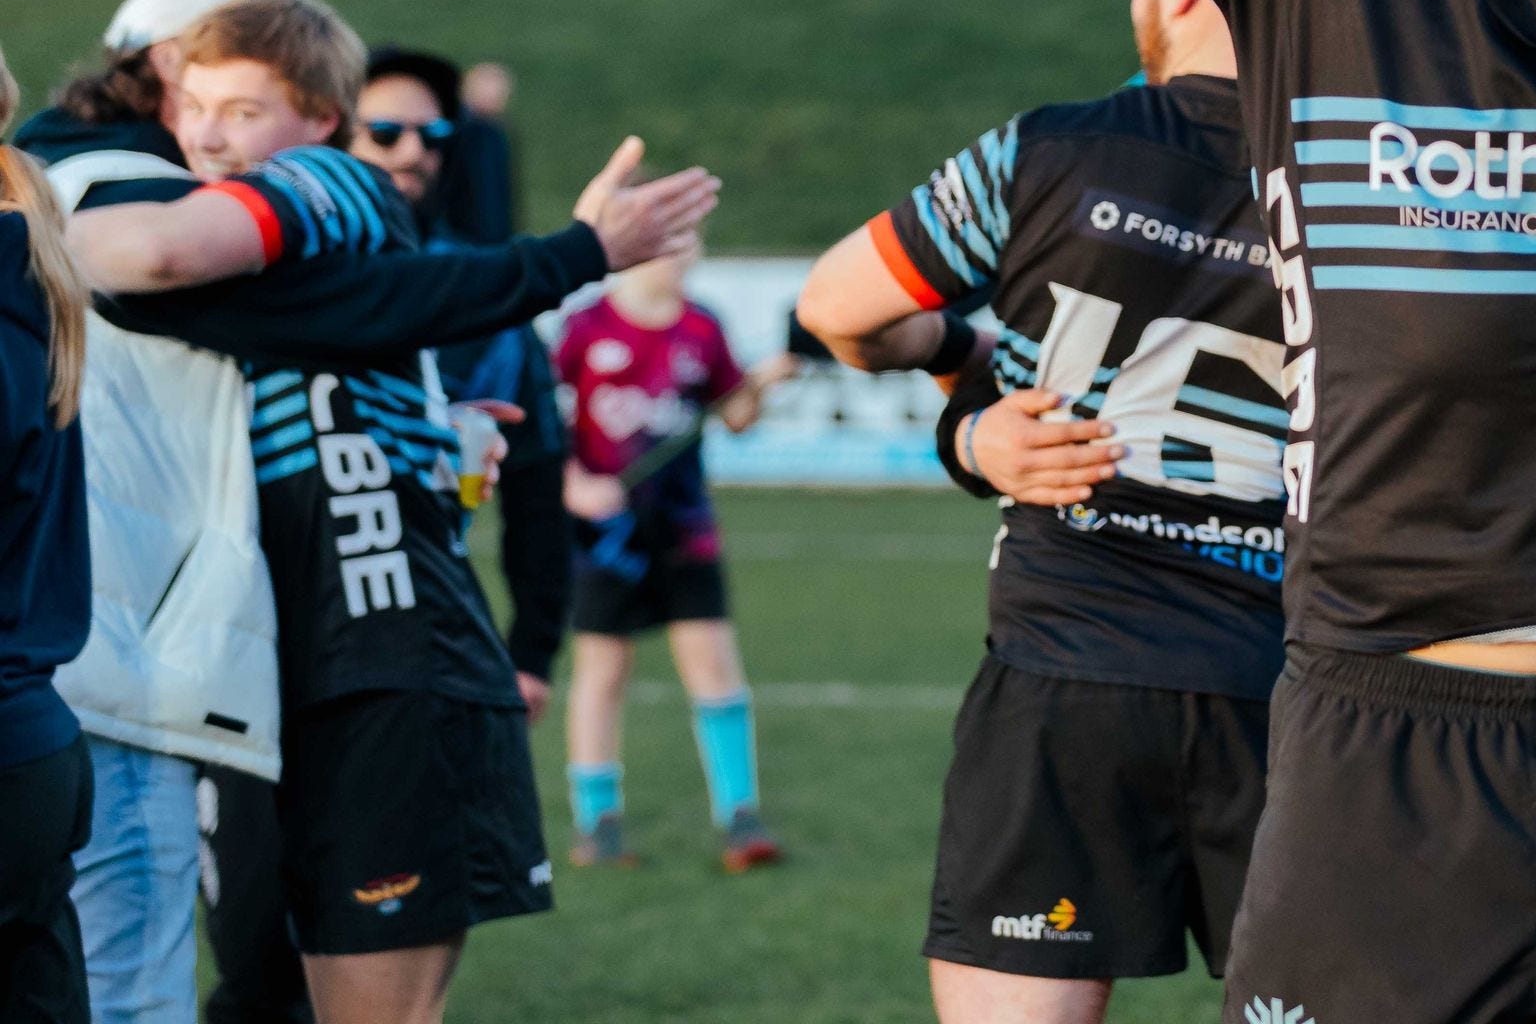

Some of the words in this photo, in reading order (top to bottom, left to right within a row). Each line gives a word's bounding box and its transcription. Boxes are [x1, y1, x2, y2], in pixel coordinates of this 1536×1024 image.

[1123, 212, 1245, 262] FORSYTH
[1036, 281, 1288, 501] 16
[991, 913, 1047, 940] mtf
